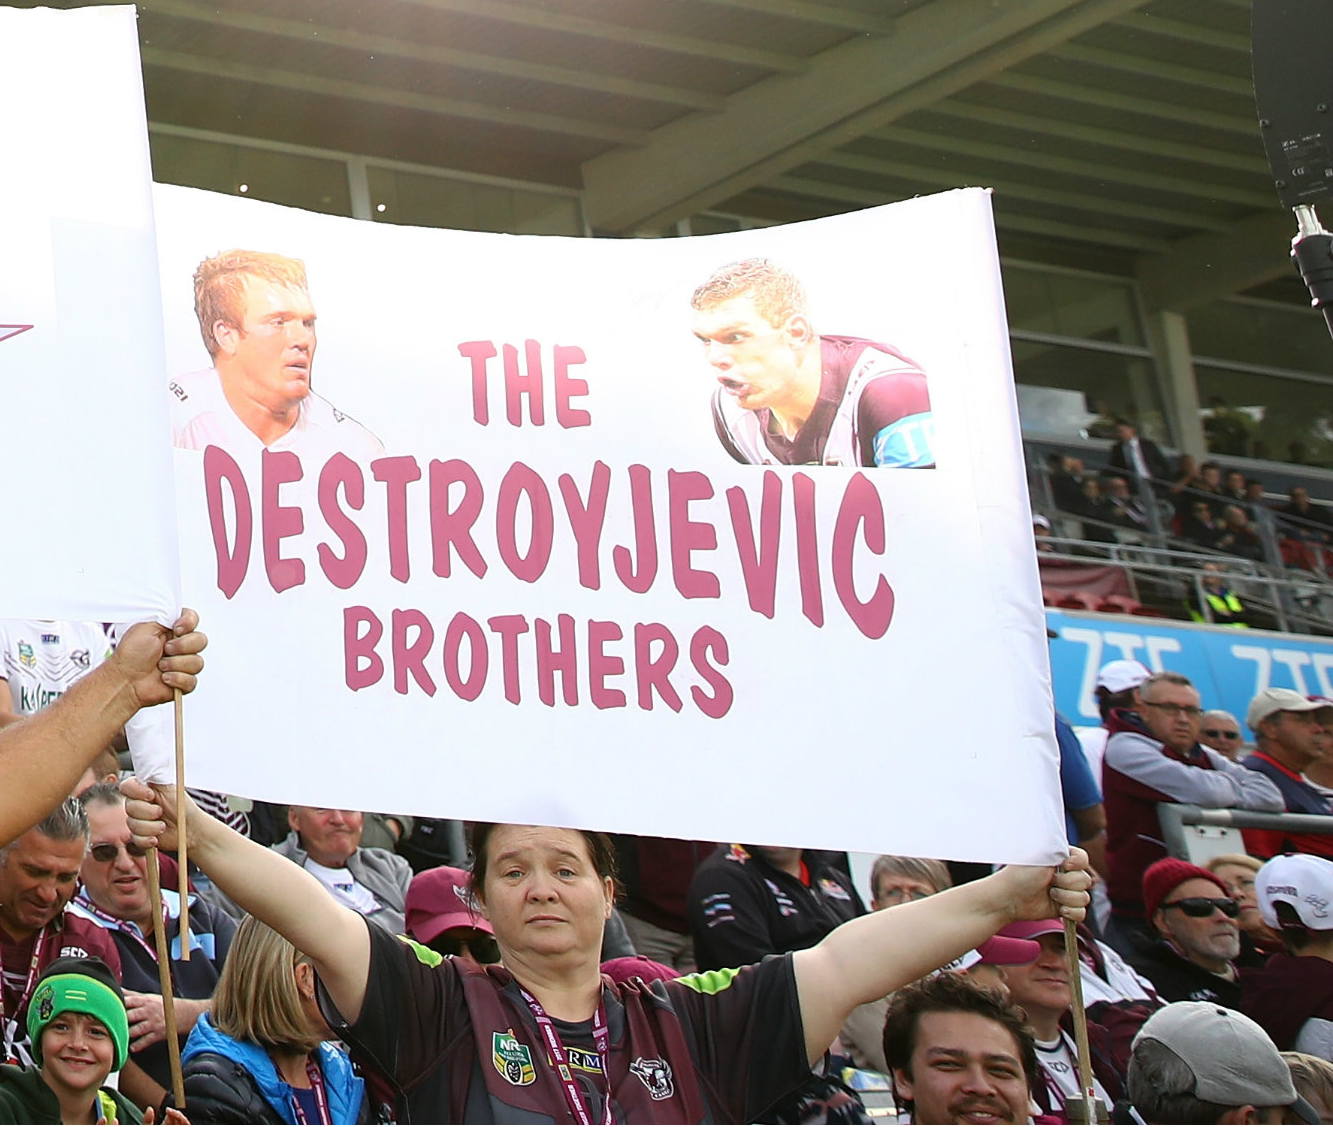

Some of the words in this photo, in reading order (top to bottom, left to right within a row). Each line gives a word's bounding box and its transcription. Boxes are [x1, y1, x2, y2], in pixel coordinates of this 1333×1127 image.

[457, 339, 592, 429] THE
[203, 443, 895, 641] DESTROYJEVIC
[343, 605, 735, 719] BROTHERS
